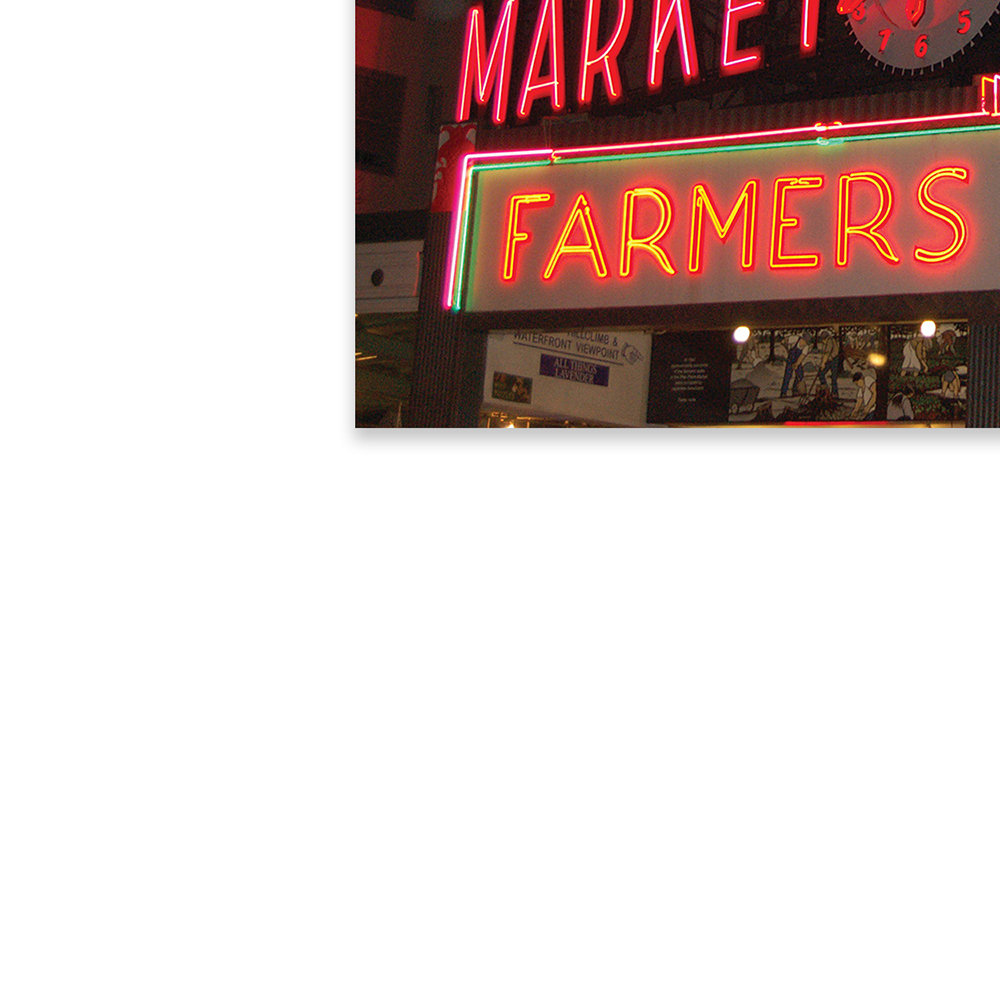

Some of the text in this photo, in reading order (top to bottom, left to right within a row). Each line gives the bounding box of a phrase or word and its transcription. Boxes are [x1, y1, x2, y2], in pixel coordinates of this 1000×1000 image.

[958, 10, 971, 34] 5
[878, 28, 892, 53] 7
[914, 34, 927, 57] 6
[500, 166, 970, 281] FARMERS
[513, 332, 620, 360] WATERFRONT VIEWPOINT
[612, 336, 618, 347] &
[554, 358, 597, 374] ALL THINGS
[555, 367, 594, 384] LAVENDER
